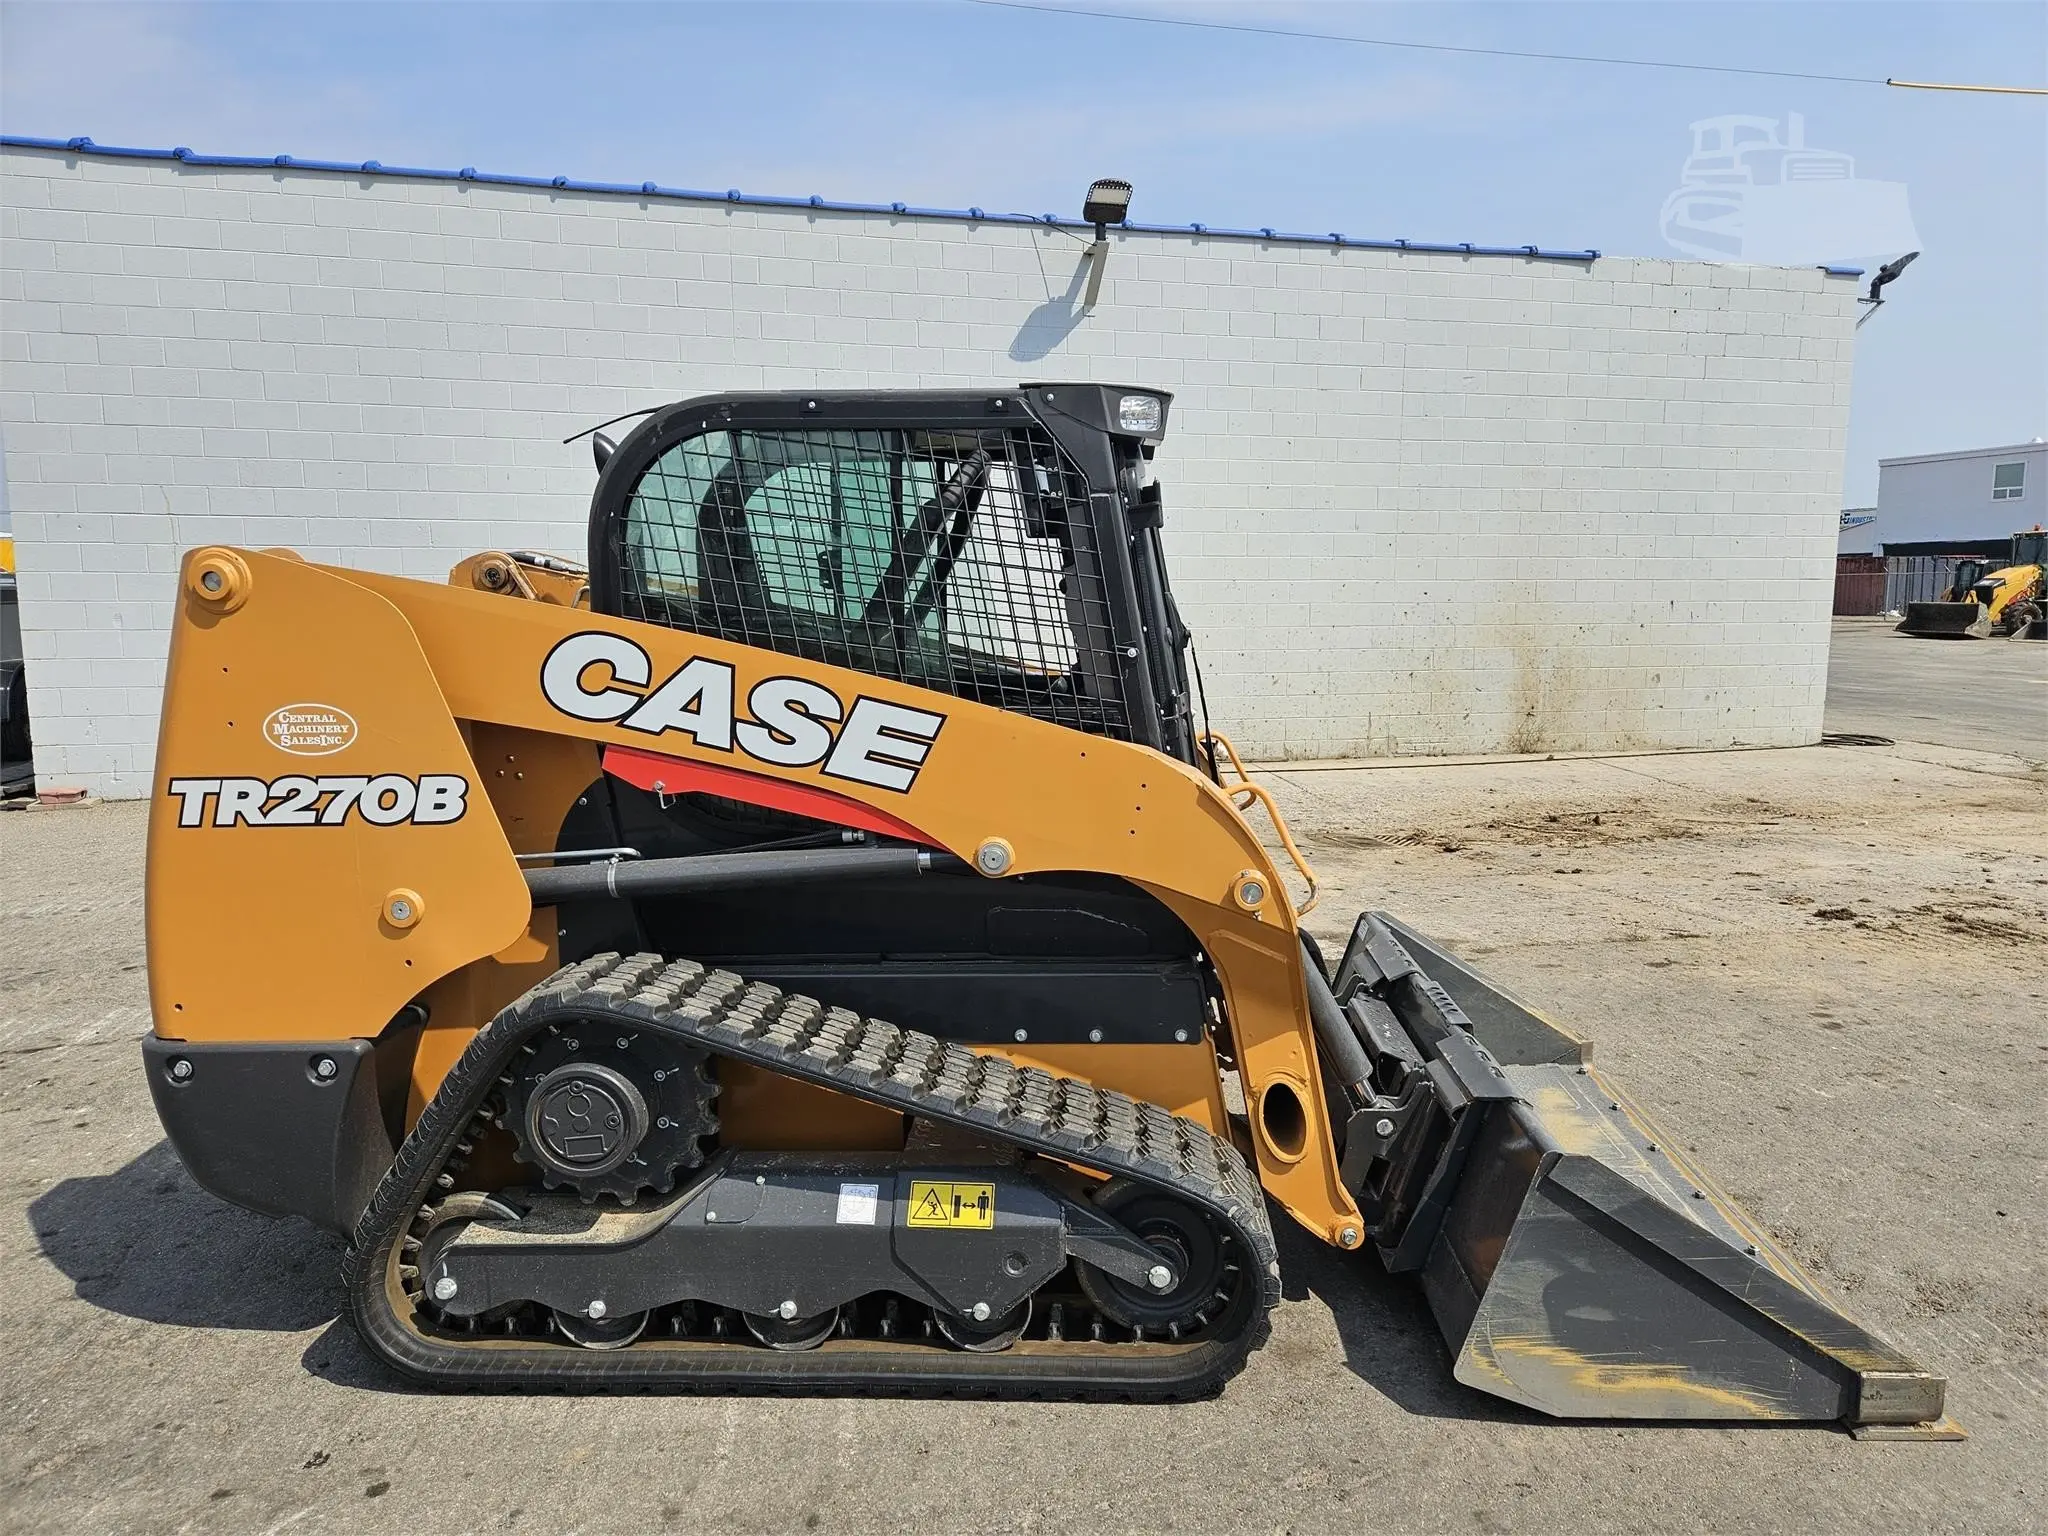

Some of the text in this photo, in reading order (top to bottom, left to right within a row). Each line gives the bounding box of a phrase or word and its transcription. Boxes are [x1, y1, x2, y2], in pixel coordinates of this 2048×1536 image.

[272, 723, 349, 735] MACHINERY
[279, 711, 337, 723] CENTRAL
[540, 630, 948, 795] CASE
[168, 774, 470, 829] TR270B
